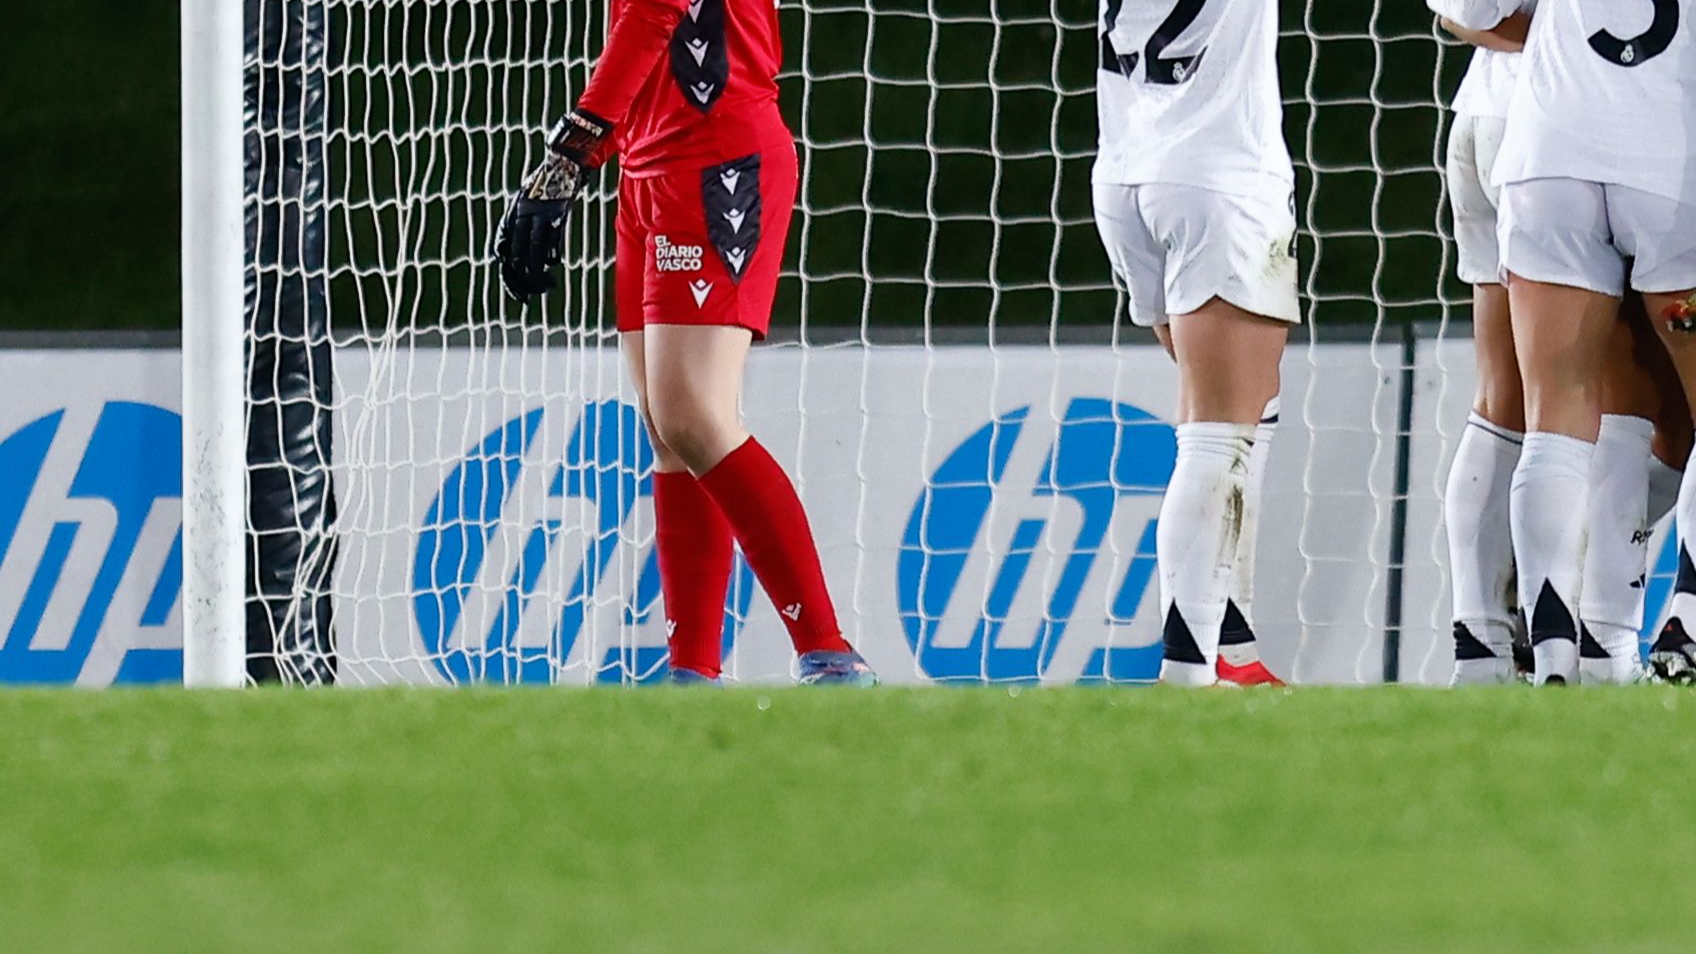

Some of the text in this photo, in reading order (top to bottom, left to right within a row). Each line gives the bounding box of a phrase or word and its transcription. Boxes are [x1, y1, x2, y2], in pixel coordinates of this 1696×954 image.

[655, 235, 671, 247] EL
[656, 245, 703, 259] DIARIO
[656, 258, 702, 272] VASCO
[930, 395, 1164, 685] hp
